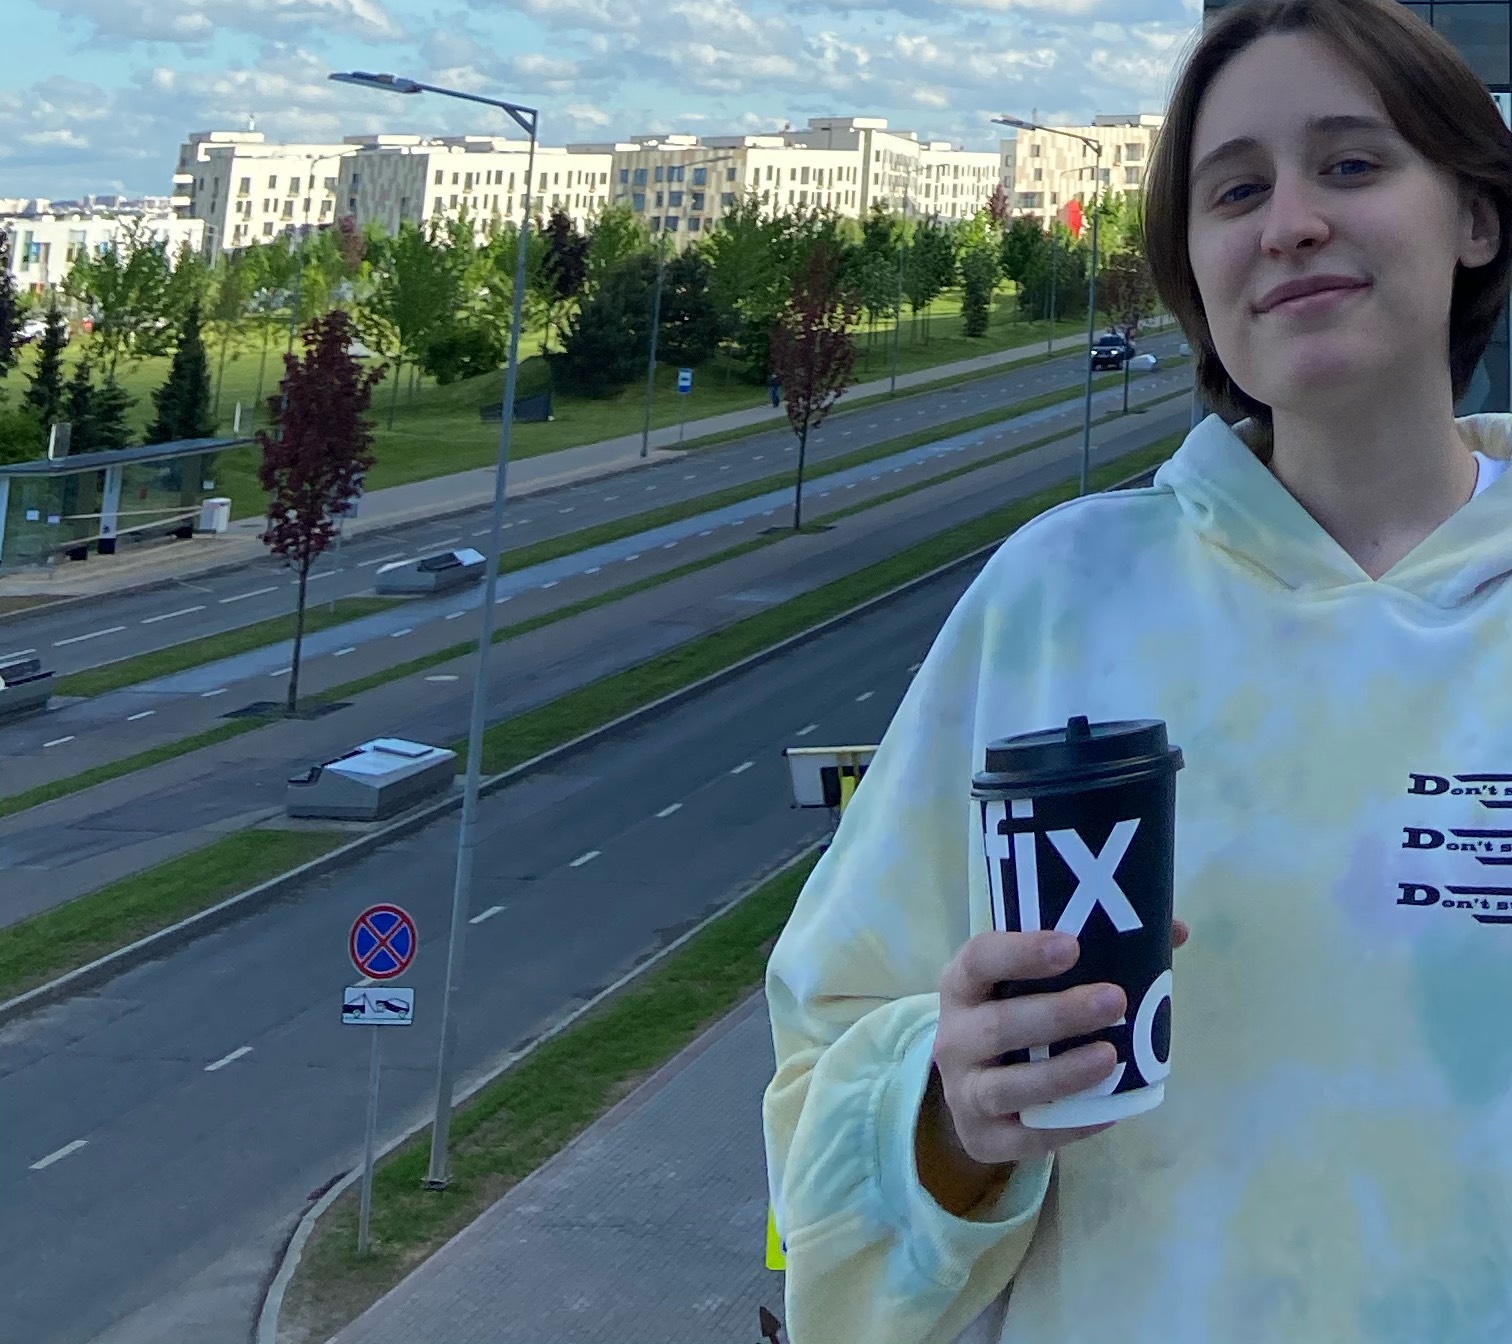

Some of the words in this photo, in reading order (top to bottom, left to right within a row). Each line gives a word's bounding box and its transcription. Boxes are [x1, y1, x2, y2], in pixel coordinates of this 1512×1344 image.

[1407, 772, 1498, 796] Don't
[1401, 826, 1494, 852] Don't
[1396, 882, 1490, 910] Don't
